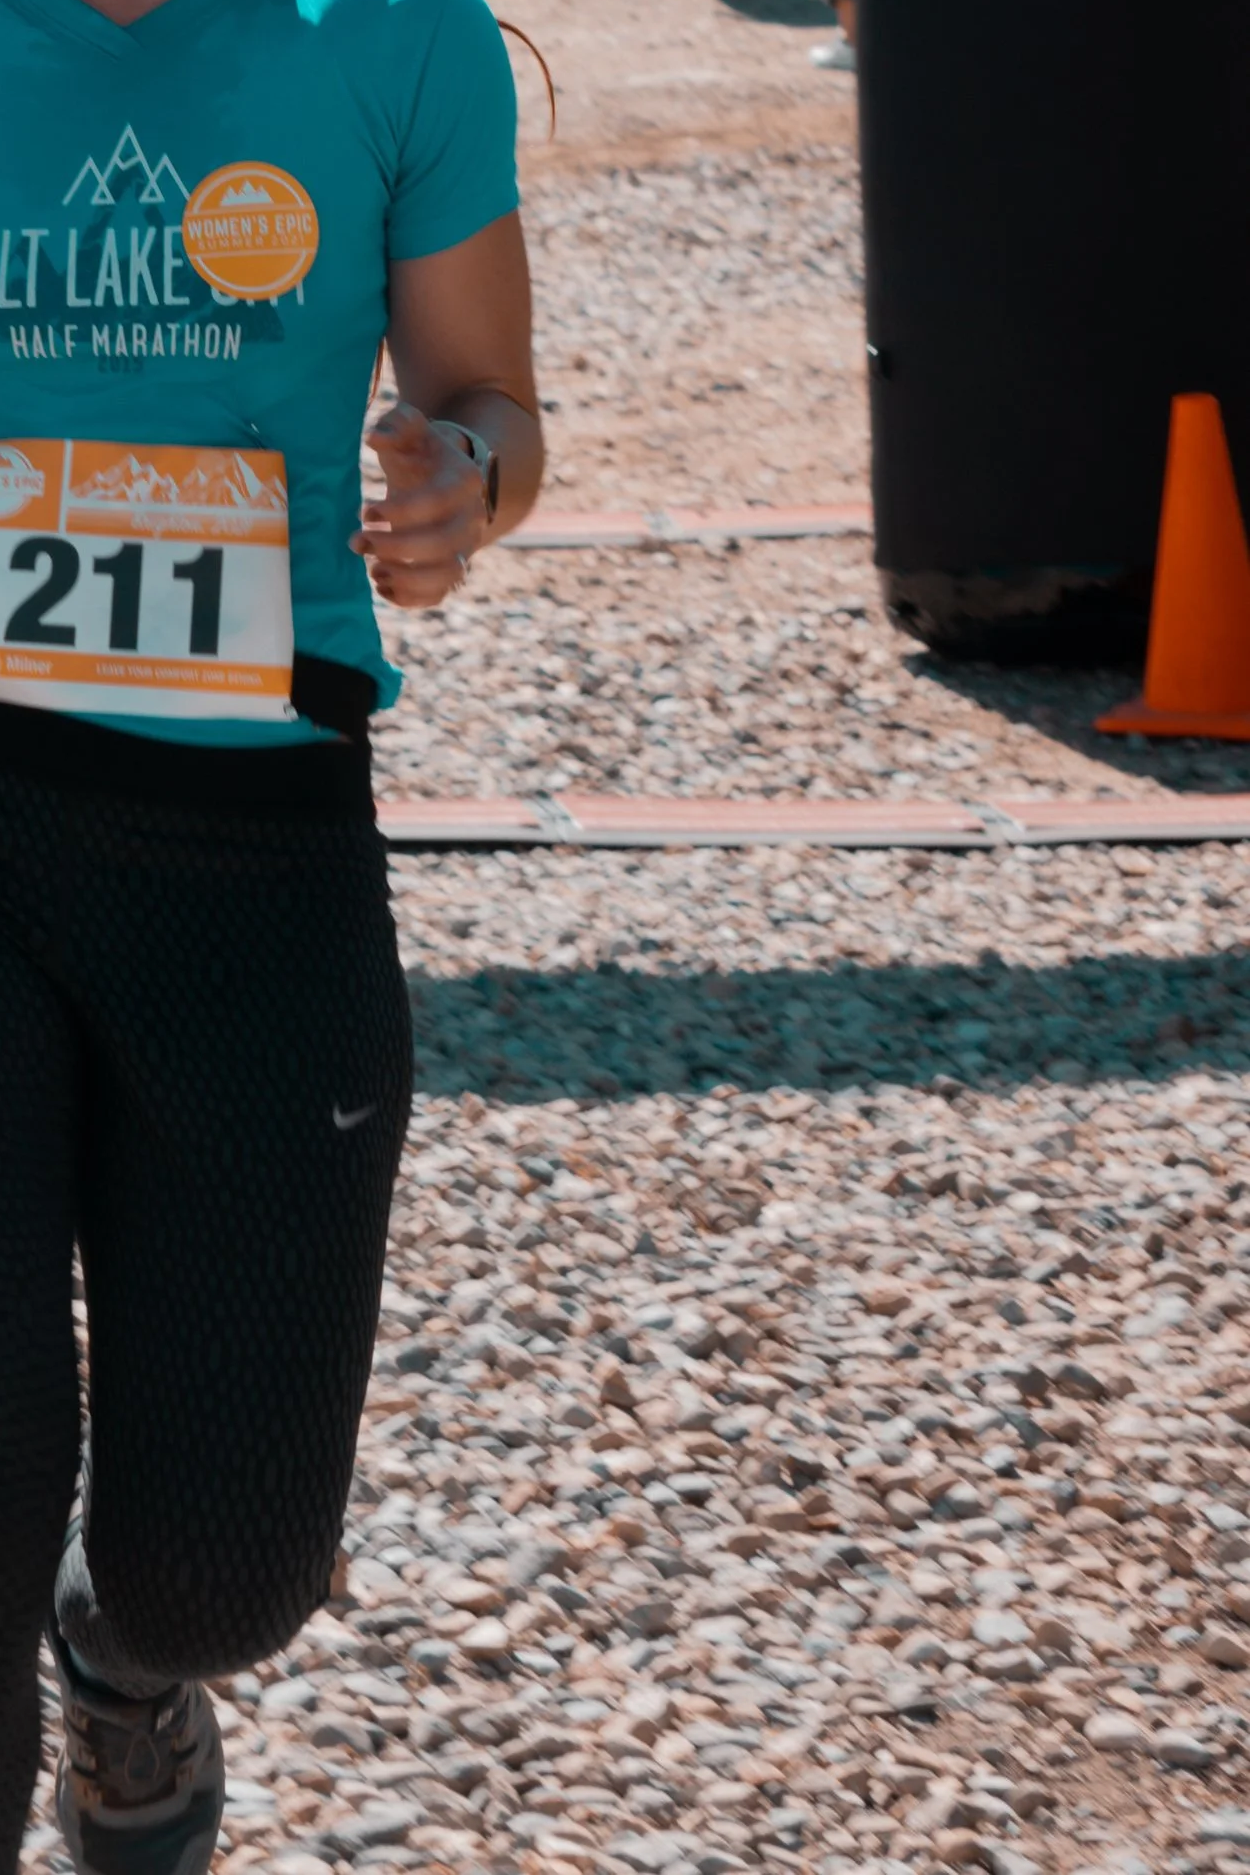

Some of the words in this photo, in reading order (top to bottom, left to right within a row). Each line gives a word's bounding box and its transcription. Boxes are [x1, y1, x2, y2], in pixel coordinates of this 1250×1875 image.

[187, 214, 269, 240] WOMEN'S
[275, 212, 312, 234] EPIC
[66, 225, 191, 308] LAKE
[9, 323, 78, 359] HALF
[91, 322, 242, 361] MARATHON
[3, 535, 224, 657] 211
